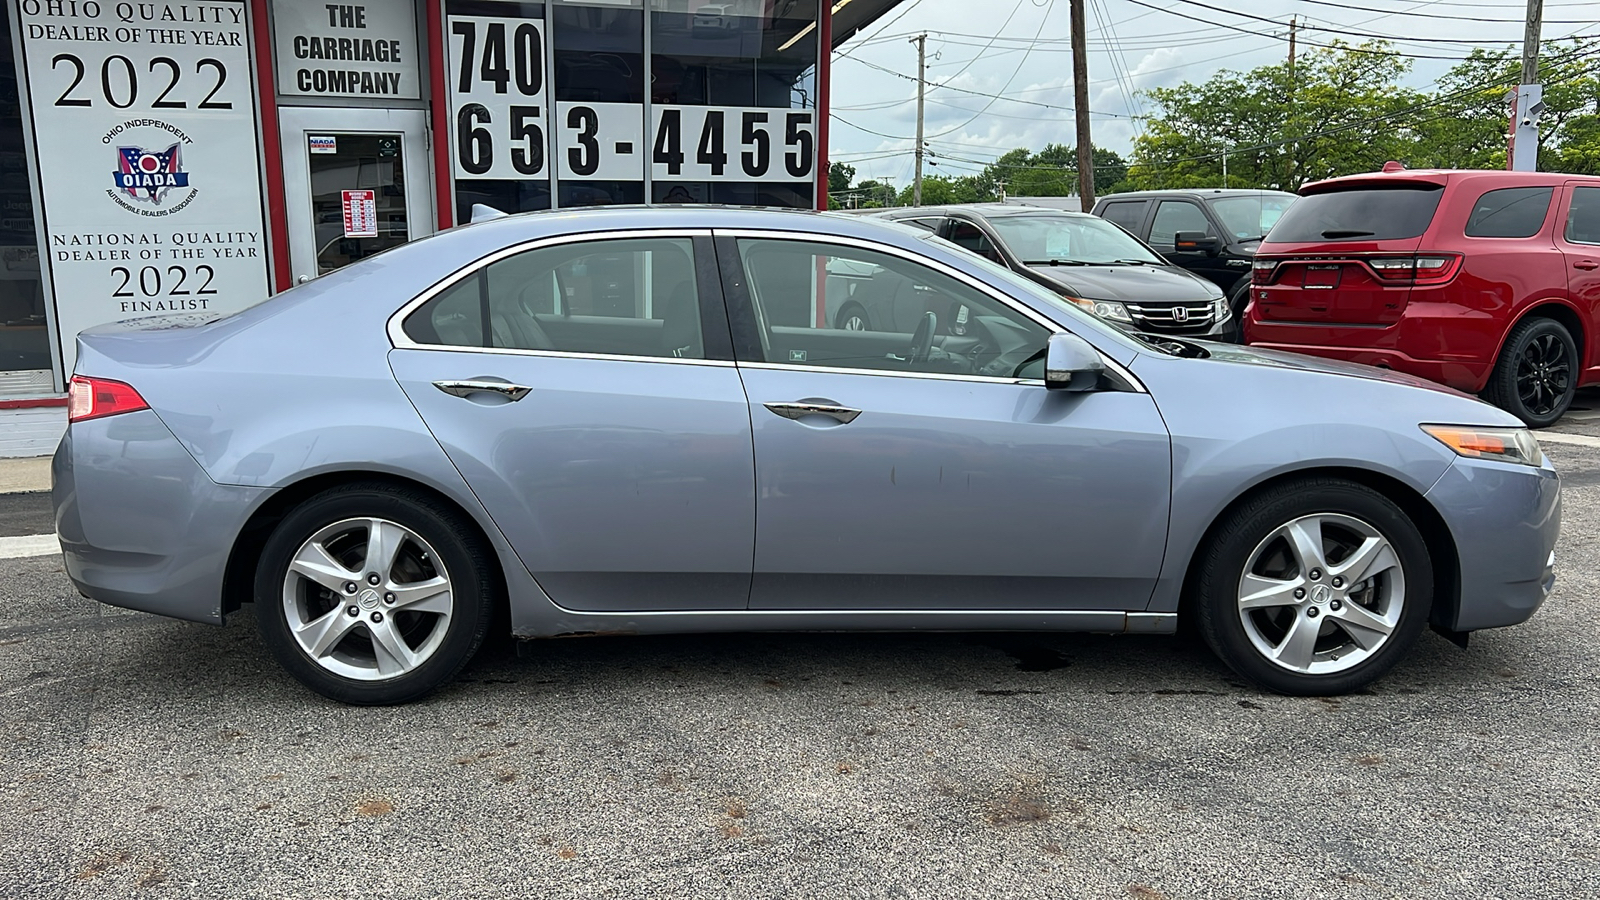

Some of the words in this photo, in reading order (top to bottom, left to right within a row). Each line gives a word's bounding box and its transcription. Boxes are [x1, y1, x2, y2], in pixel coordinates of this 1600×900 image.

[23, 0, 101, 18] OHIO
[116, 2, 243, 24] QUALITY
[325, 4, 367, 28] THE
[28, 24, 111, 42] DEALER
[115, 27, 141, 43] OF
[146, 29, 186, 45] THE
[191, 30, 243, 47] YEAR
[293, 36, 402, 62] CARRIAGE
[452, 21, 543, 96] 740
[51, 53, 234, 110] 2022
[297, 69, 402, 94] COMPANY
[102, 125, 124, 144] OHIO
[124, 119, 194, 145] INDEPENDENT
[123, 173, 177, 187] OIADA
[106, 188, 140, 215] AUTOMOBILE
[141, 209, 168, 217] DEALERS
[168, 187, 199, 215] ASSOCIATION
[53, 233, 163, 246] NATIONAL
[172, 232, 259, 246] QUALITY
[58, 250, 131, 262] DEALER
[140, 250, 162, 260] OF
[170, 249, 205, 260] THE
[213, 248, 258, 259] YEAR
[110, 264, 218, 298] 2022
[121, 299, 209, 312] FINALIST
